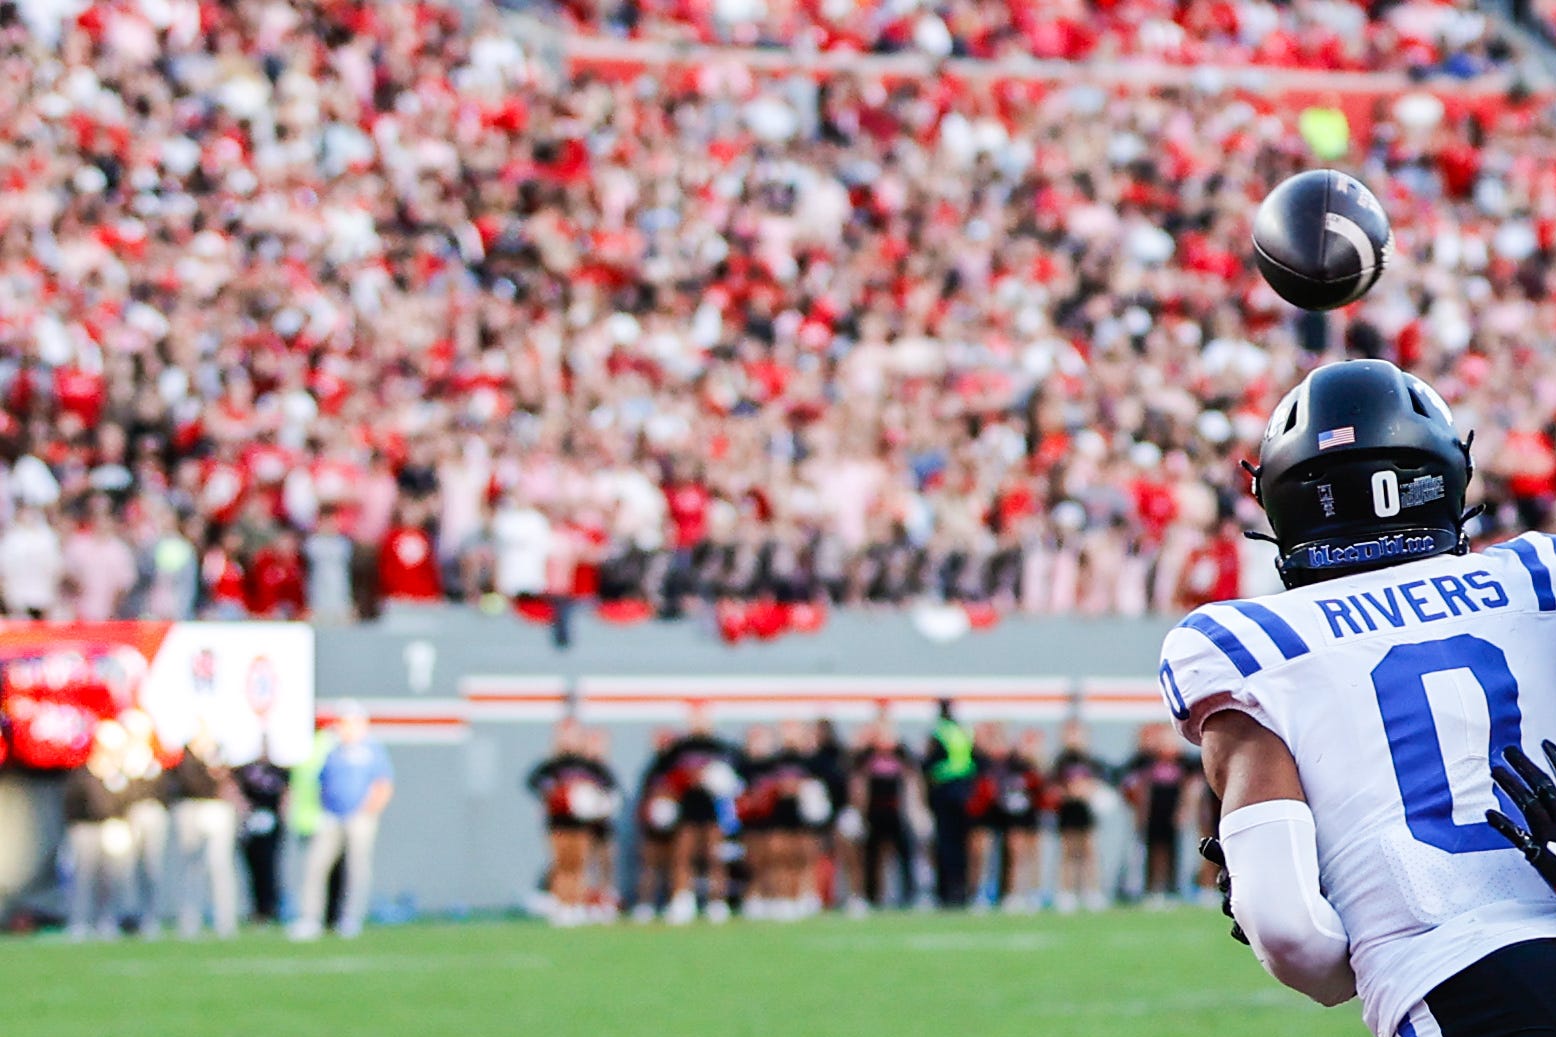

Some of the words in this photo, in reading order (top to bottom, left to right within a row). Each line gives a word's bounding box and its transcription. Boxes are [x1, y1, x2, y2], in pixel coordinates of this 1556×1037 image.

[1371, 470, 1400, 518] 0
[1315, 570, 1509, 638] RIVERS
[1159, 658, 1190, 720] 0
[1371, 633, 1531, 855] 0
